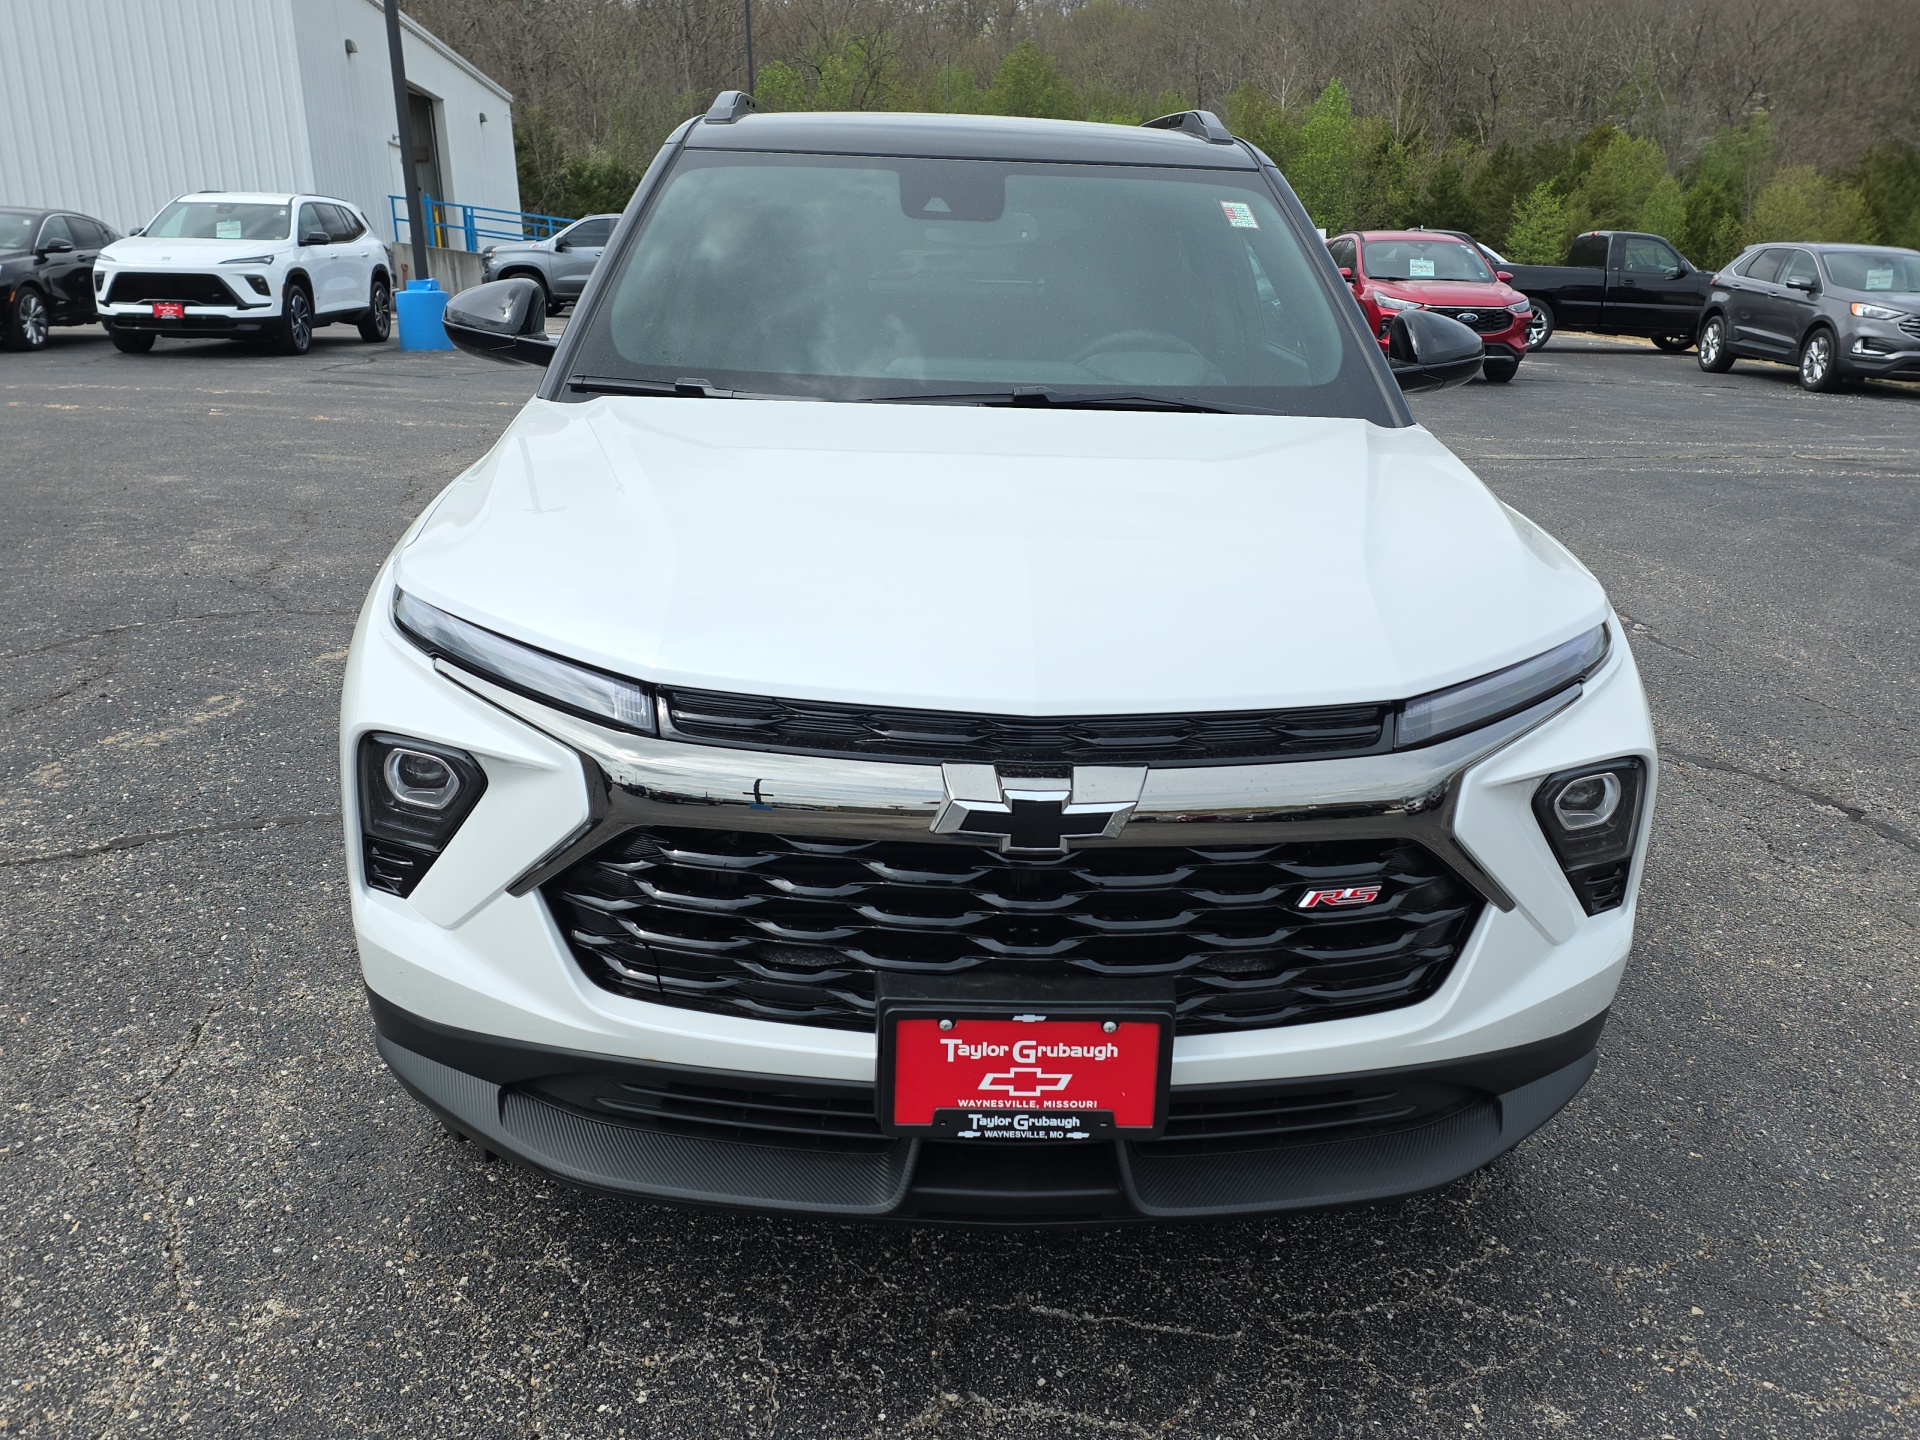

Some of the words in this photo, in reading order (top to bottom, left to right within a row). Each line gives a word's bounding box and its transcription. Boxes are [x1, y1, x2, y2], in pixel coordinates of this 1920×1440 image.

[1298, 885, 1382, 908] RS
[940, 1039, 1009, 1062] Taylor
[1012, 1040, 1118, 1063] Grubaugh
[958, 1099, 1039, 1109] WAYNESVILLE,
[1044, 1100, 1097, 1109] MISSOURI
[968, 1114, 1011, 1129] Taylor
[1013, 1115, 1080, 1130] Grubaugh
[984, 1130, 1047, 1139] WAYNESVILLE,
[1050, 1131, 1064, 1139] MO
